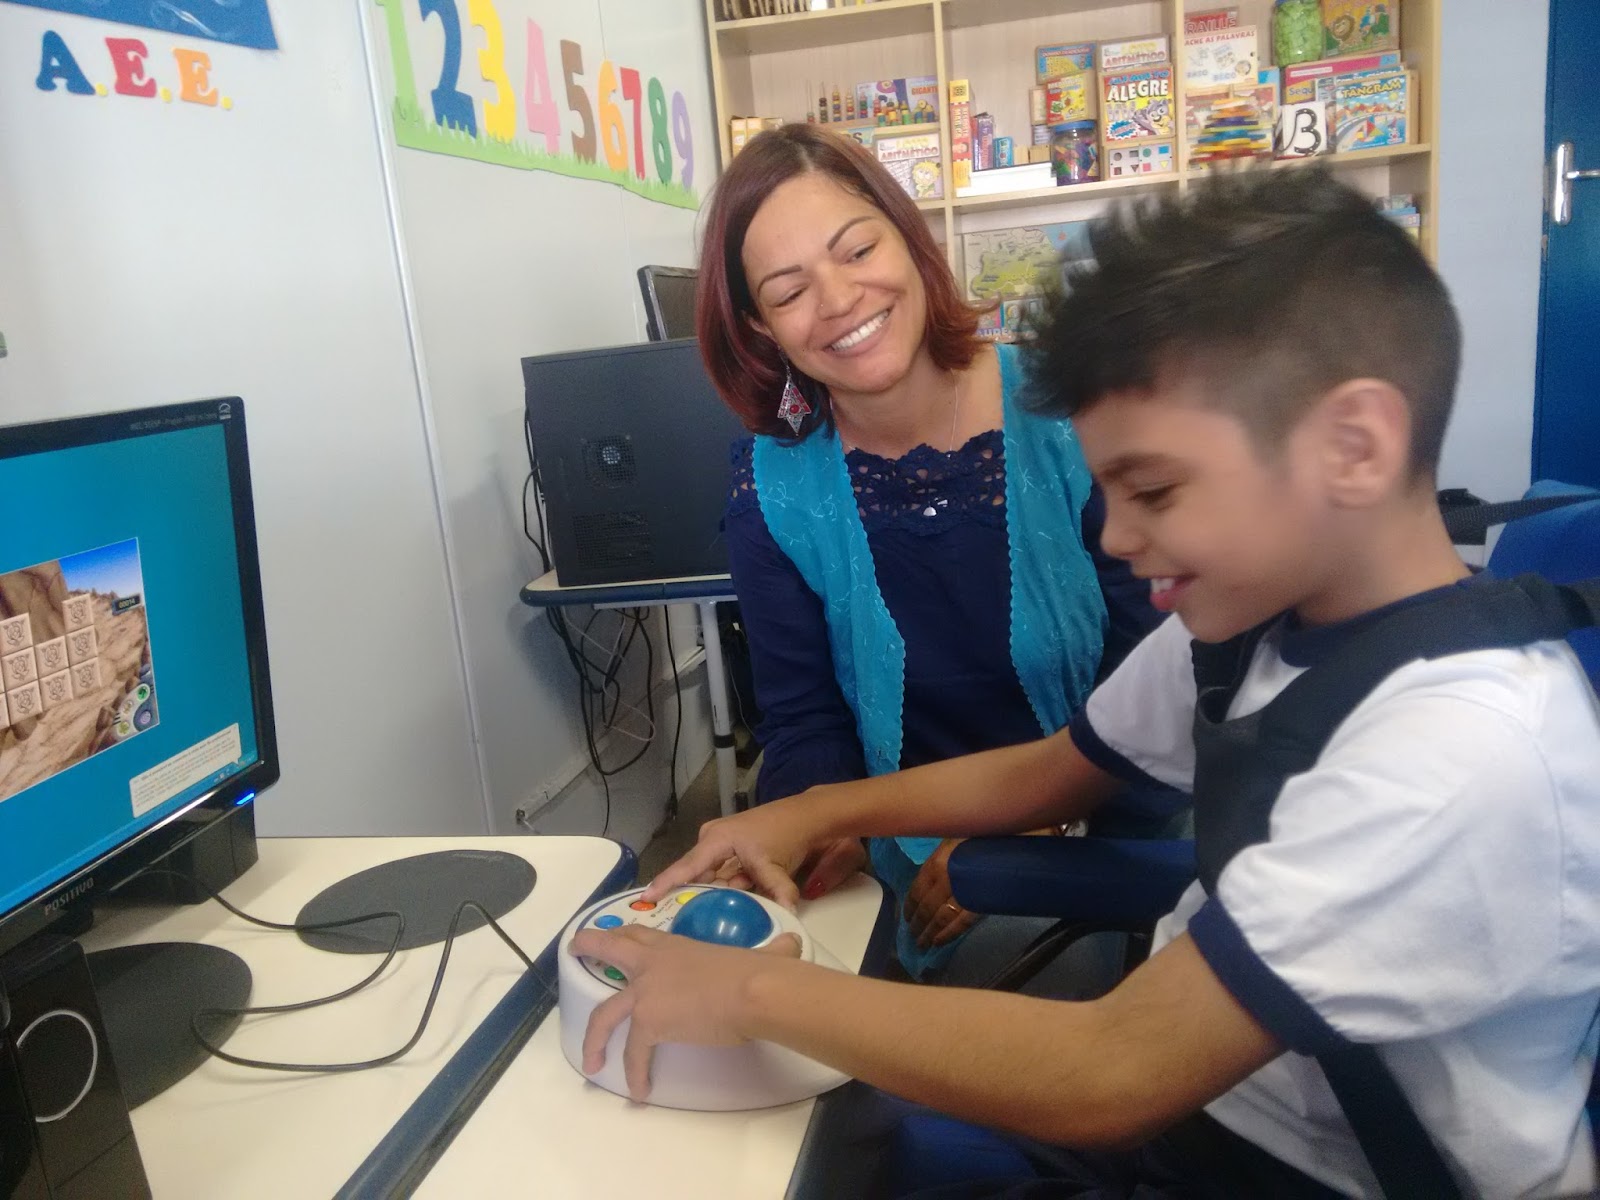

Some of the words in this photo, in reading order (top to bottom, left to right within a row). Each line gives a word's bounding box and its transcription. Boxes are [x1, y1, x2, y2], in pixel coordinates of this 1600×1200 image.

[1184, 18, 1237, 35] RAILLE
[1184, 38, 1204, 46] ACHE
[1216, 30, 1255, 41] PALAVRAS
[418, 0, 477, 139] 2
[468, 0, 516, 143] 3
[525, 17, 560, 156] 4
[560, 39, 597, 164] 5
[598, 60, 629, 173] 6
[620, 67, 645, 181] 7
[648, 77, 673, 186] 8
[672, 91, 694, 193] 9
[1106, 79, 1169, 102] ALEGRE
[1342, 79, 1402, 99] TANGRAM
[44, 877, 94, 916] POSITIVO
